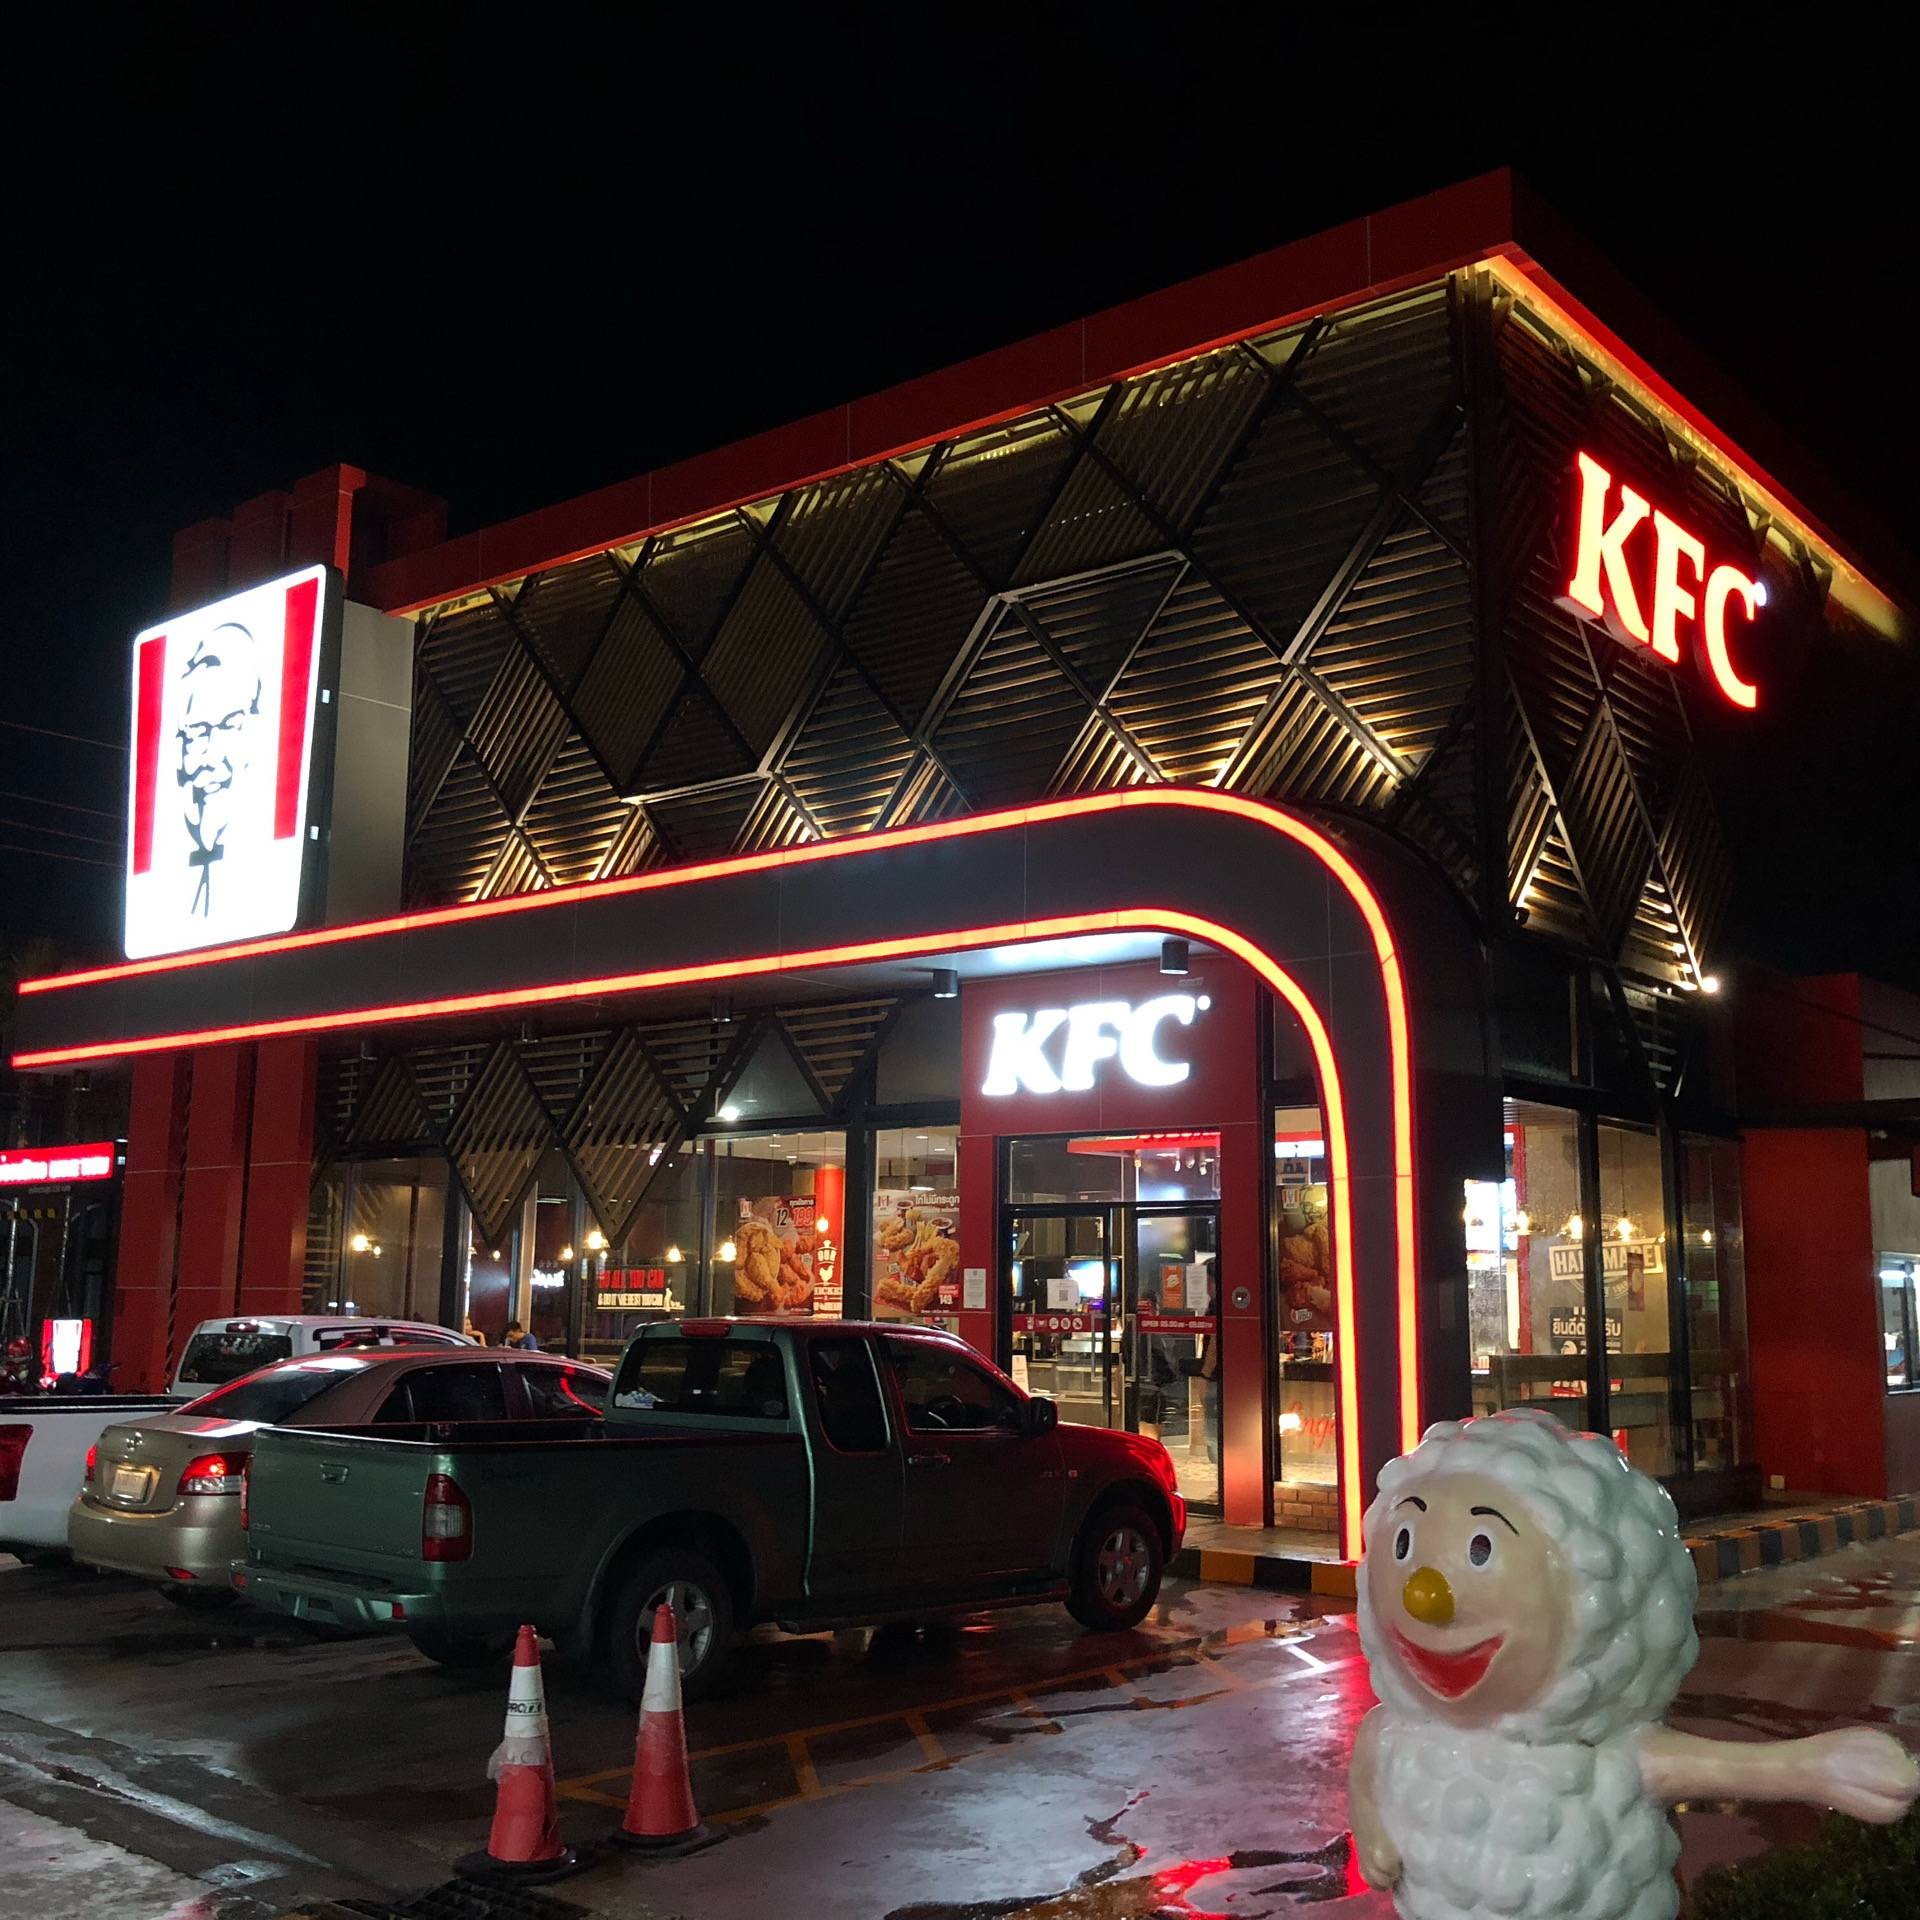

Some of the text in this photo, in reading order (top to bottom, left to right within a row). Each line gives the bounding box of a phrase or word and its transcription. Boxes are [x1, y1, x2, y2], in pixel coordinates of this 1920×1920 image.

[1568, 450, 1758, 708] KFC
[981, 994, 1197, 1097] KFC
[1555, 1244, 1655, 1275] HAMAE
